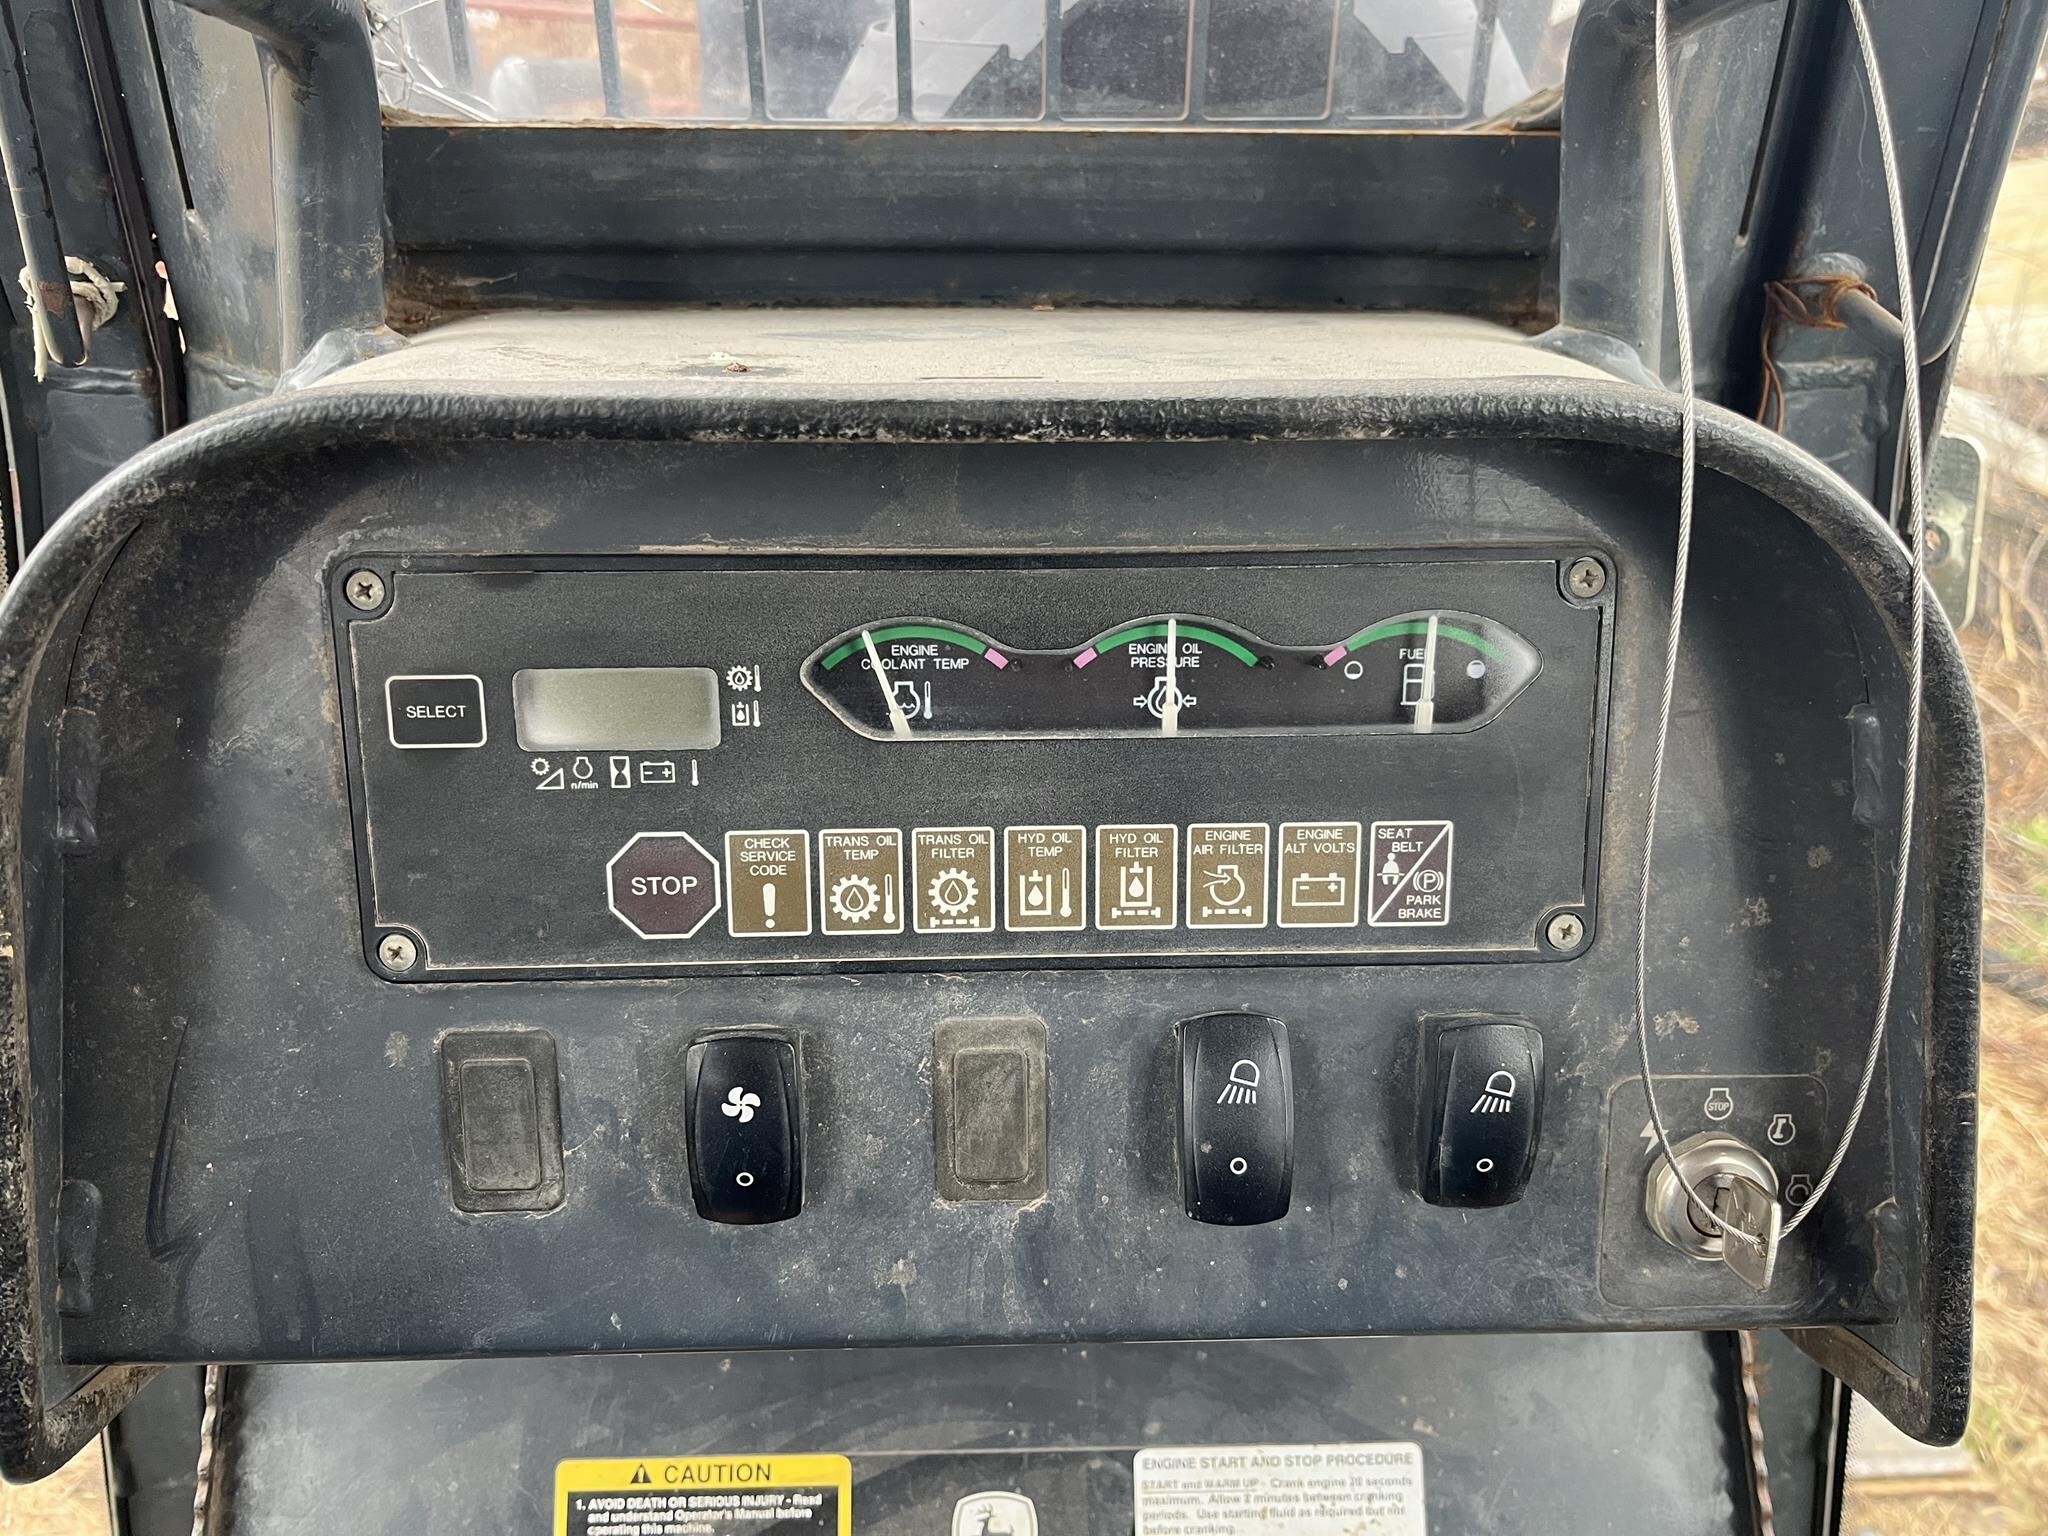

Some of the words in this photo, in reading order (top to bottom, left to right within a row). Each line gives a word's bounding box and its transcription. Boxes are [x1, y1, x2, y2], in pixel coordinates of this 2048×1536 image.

[891, 645, 939, 656] ENGINE
[1128, 643, 1168, 655] ENGIN
[1182, 642, 1202, 654] OIL
[1399, 648, 1425, 660] FUE
[933, 658, 969, 669] TEMP
[1130, 656, 1200, 668] PRESURE
[406, 705, 467, 719] SELECT
[570, 780, 599, 790] n/min
[918, 834, 962, 845] TRANS
[968, 833, 989, 845] OIL
[1017, 833, 1046, 844] HYD
[1052, 832, 1073, 844] OIL
[1109, 833, 1137, 844] HYD
[1143, 832, 1164, 844] OIL
[1205, 830, 1252, 841] ENGINE
[1296, 829, 1343, 841] ENGINE
[1378, 828, 1413, 840] SEAT
[744, 837, 790, 849] CHECK
[825, 835, 870, 847] TRANS
[876, 835, 897, 847] OIL
[1391, 841, 1424, 853] BELT
[931, 848, 975, 859] FILTER
[1029, 847, 1063, 858] TEMP
[1115, 848, 1158, 859] FILTER
[1193, 844, 1213, 856] AIR
[1220, 844, 1264, 855] FILTER
[1284, 843, 1308, 854] ALT
[1314, 843, 1356, 854] VOLTS
[740, 850, 796, 862] SERVICE
[844, 849, 879, 861] TEMP
[750, 864, 788, 877] CODE
[631, 875, 698, 896] STOP
[1406, 894, 1442, 906] PARK
[1398, 907, 1442, 919] BRAKE
[1707, 1102, 1730, 1112] STOP
[1143, 1457, 1197, 1469] ENGINE
[1200, 1456, 1246, 1468] START
[1250, 1455, 1280, 1467] AND
[1284, 1454, 1321, 1466] STOP
[1326, 1453, 1414, 1465] PROCEDURE
[664, 1463, 771, 1483] CAUTION
[575, 1499, 587, 1511] 1.
[587, 1498, 626, 1511] AVOID
[626, 1497, 667, 1510] DEATH
[667, 1497, 687, 1508] OR
[687, 1495, 741, 1508] SERIOUS
[741, 1494, 784, 1506] INJURY
[610, 1510, 674, 1522] understand
[733, 1507, 775, 1519] Manual
